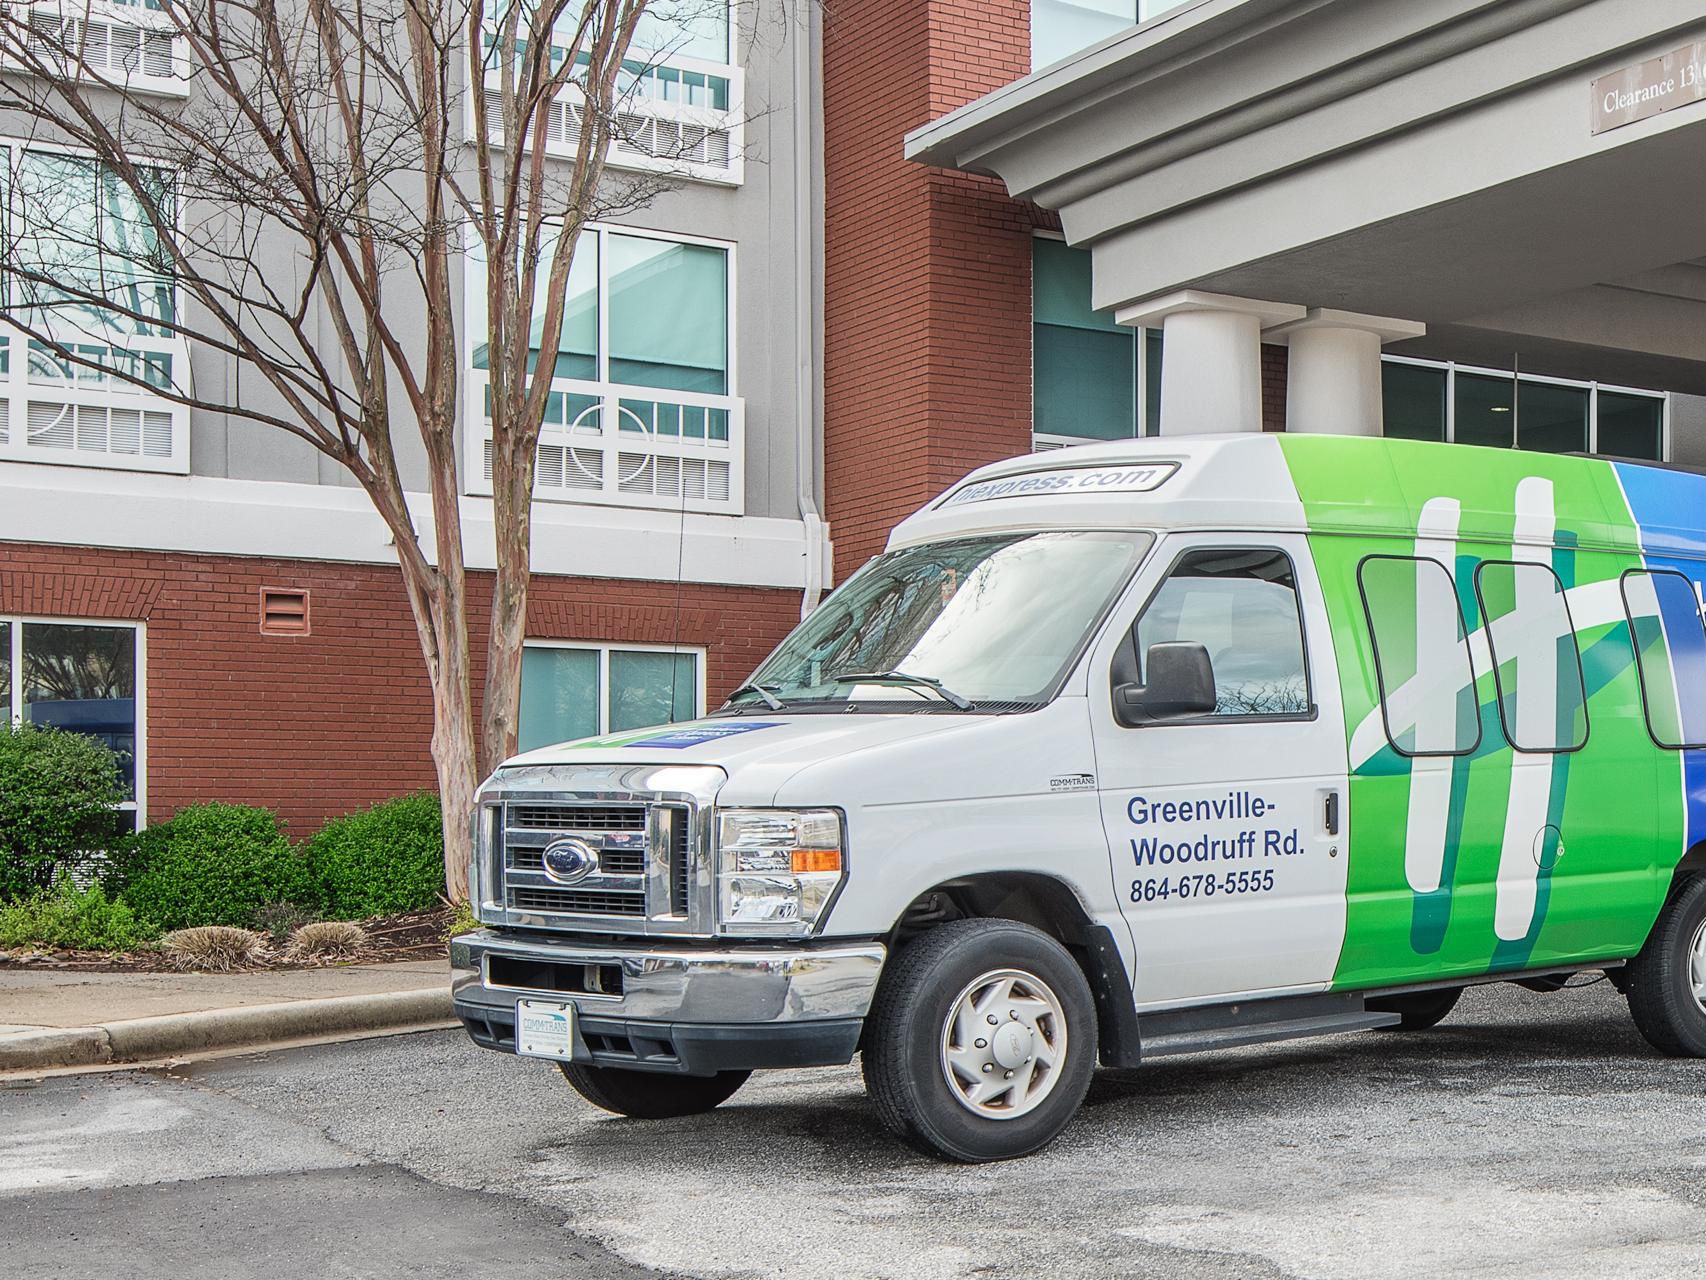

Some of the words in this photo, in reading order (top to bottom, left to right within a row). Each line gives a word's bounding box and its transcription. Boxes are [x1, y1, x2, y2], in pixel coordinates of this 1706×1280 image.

[1603, 78, 1675, 114] Clearance
[1127, 791, 1276, 825] Greenville-
[1130, 831, 1257, 867] Woodruff
[1264, 828, 1305, 857] Rd.
[1129, 869, 1275, 903] 864-678-5555
